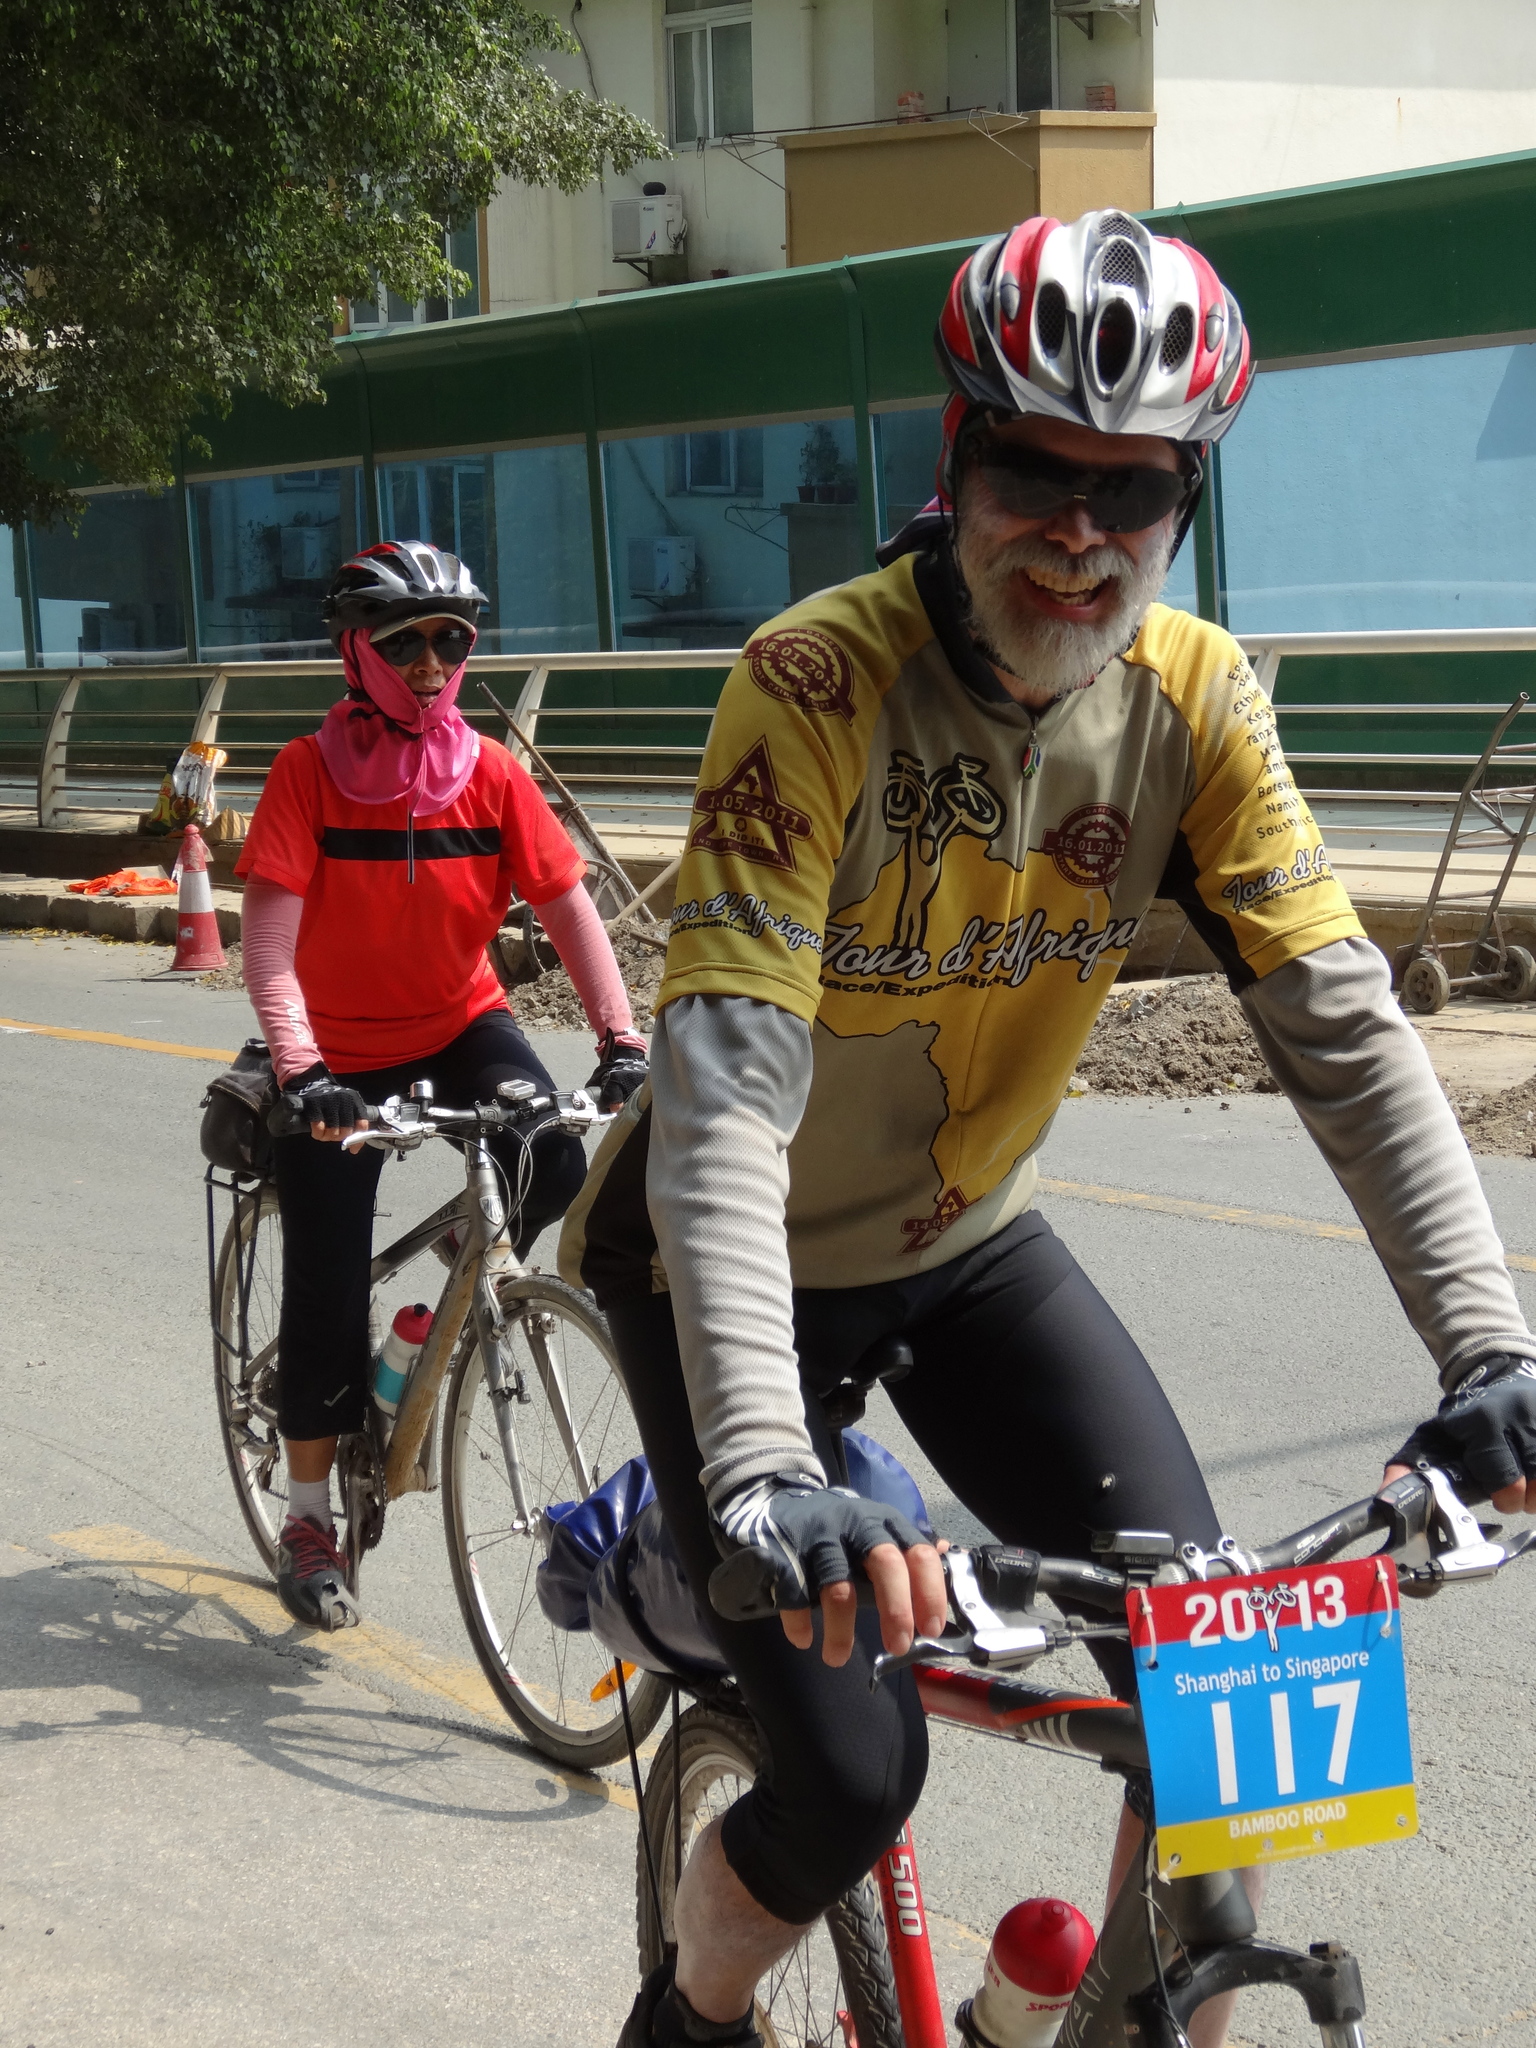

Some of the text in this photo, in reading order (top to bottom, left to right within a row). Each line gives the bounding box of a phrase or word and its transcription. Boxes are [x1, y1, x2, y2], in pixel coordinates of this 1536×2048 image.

[758, 640, 837, 697] 16.01.2011
[729, 831, 748, 842] DID
[1057, 836, 1127, 855] 16.01.2011
[1221, 866, 1289, 908] Tour
[938, 908, 1150, 988] d'Afriqu
[994, 1557, 1033, 1569] DEORE
[1184, 1576, 1347, 1649] 2013
[1174, 1650, 1370, 1695] Shanghai to Singapore
[1211, 1680, 1361, 1806] 117
[1229, 1801, 1347, 1839] BAMBOO ROAD
[888, 1854, 923, 1937] 500
